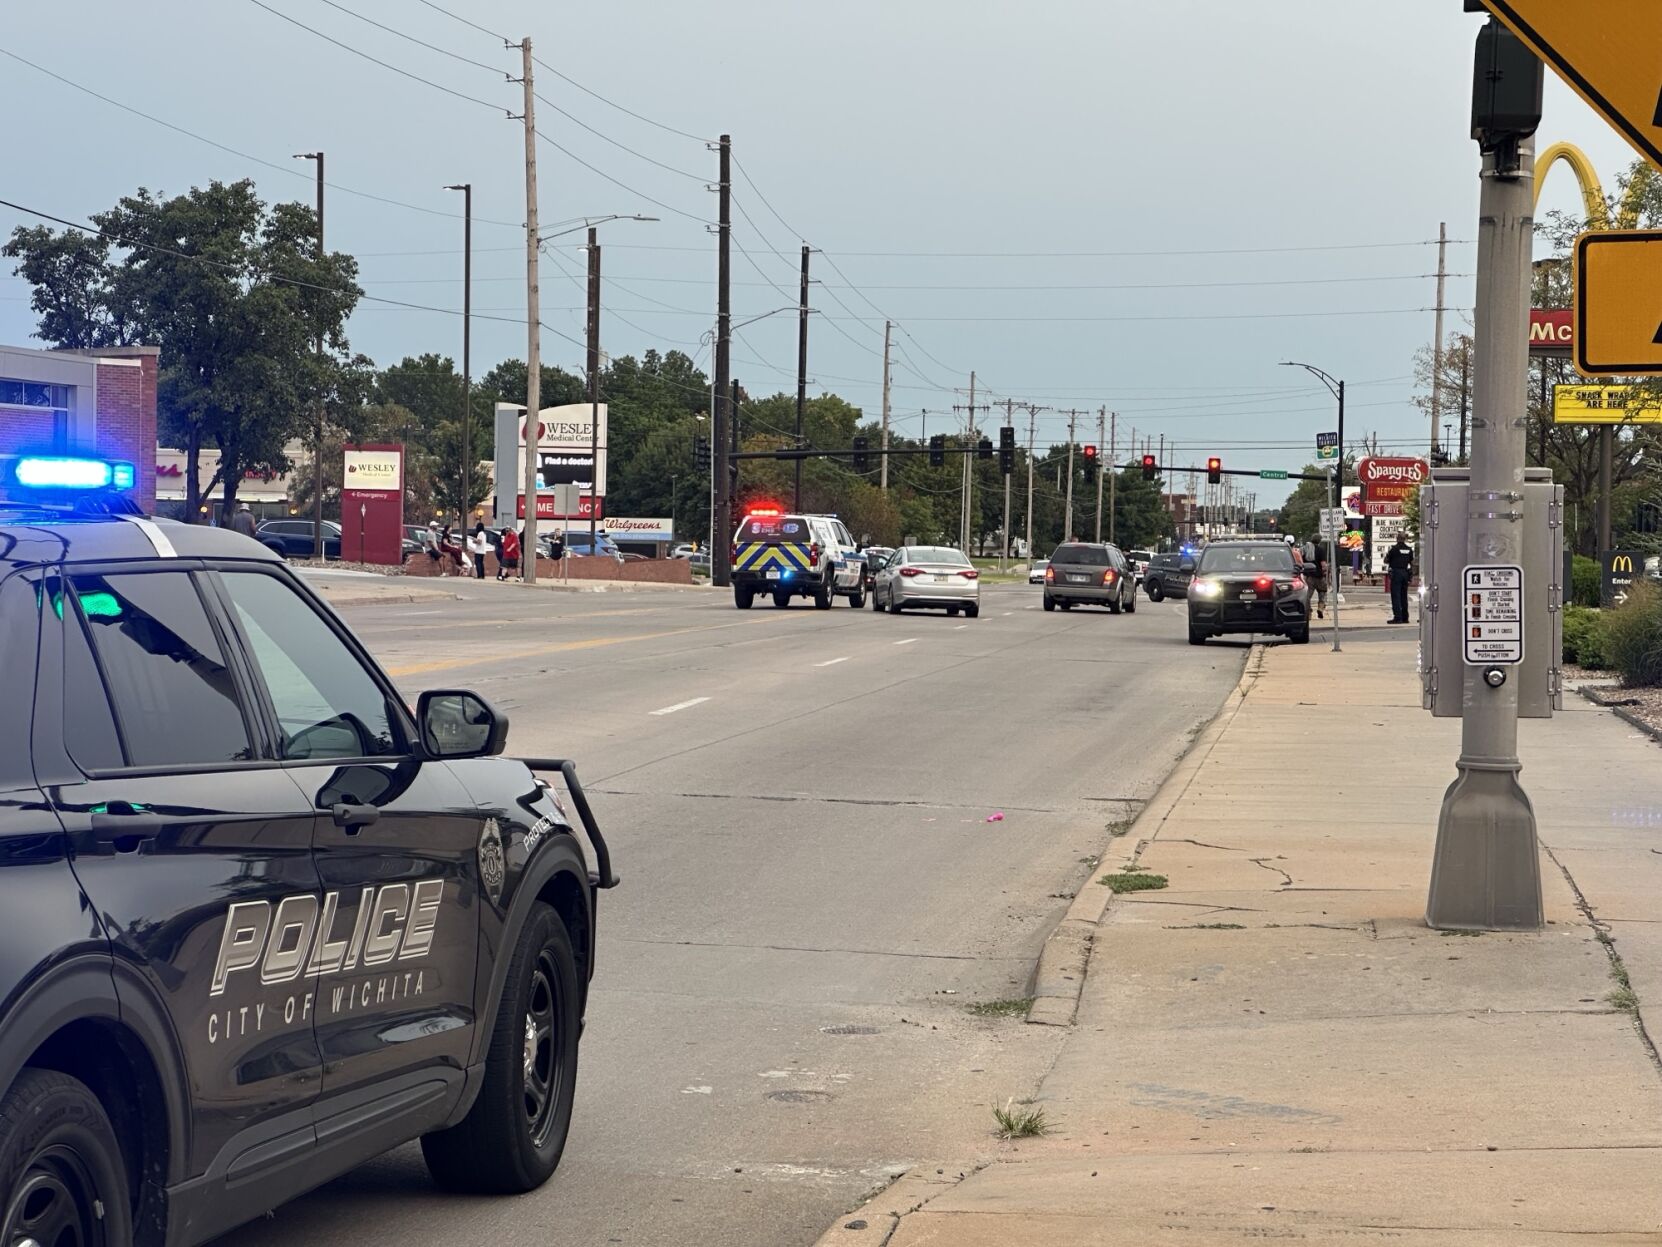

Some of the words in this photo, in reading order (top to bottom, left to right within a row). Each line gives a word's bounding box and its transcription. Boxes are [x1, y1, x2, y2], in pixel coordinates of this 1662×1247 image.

[1586, 400, 1603, 408] ARE
[546, 434, 574, 442] Medical
[358, 464, 396, 472] WESLEY
[605, 518, 662, 532] Walgreens
[210, 879, 444, 996] POLICE
[208, 1002, 264, 1044] CITY
[284, 993, 312, 1024] OF
[332, 970, 423, 1014] WICHITA
